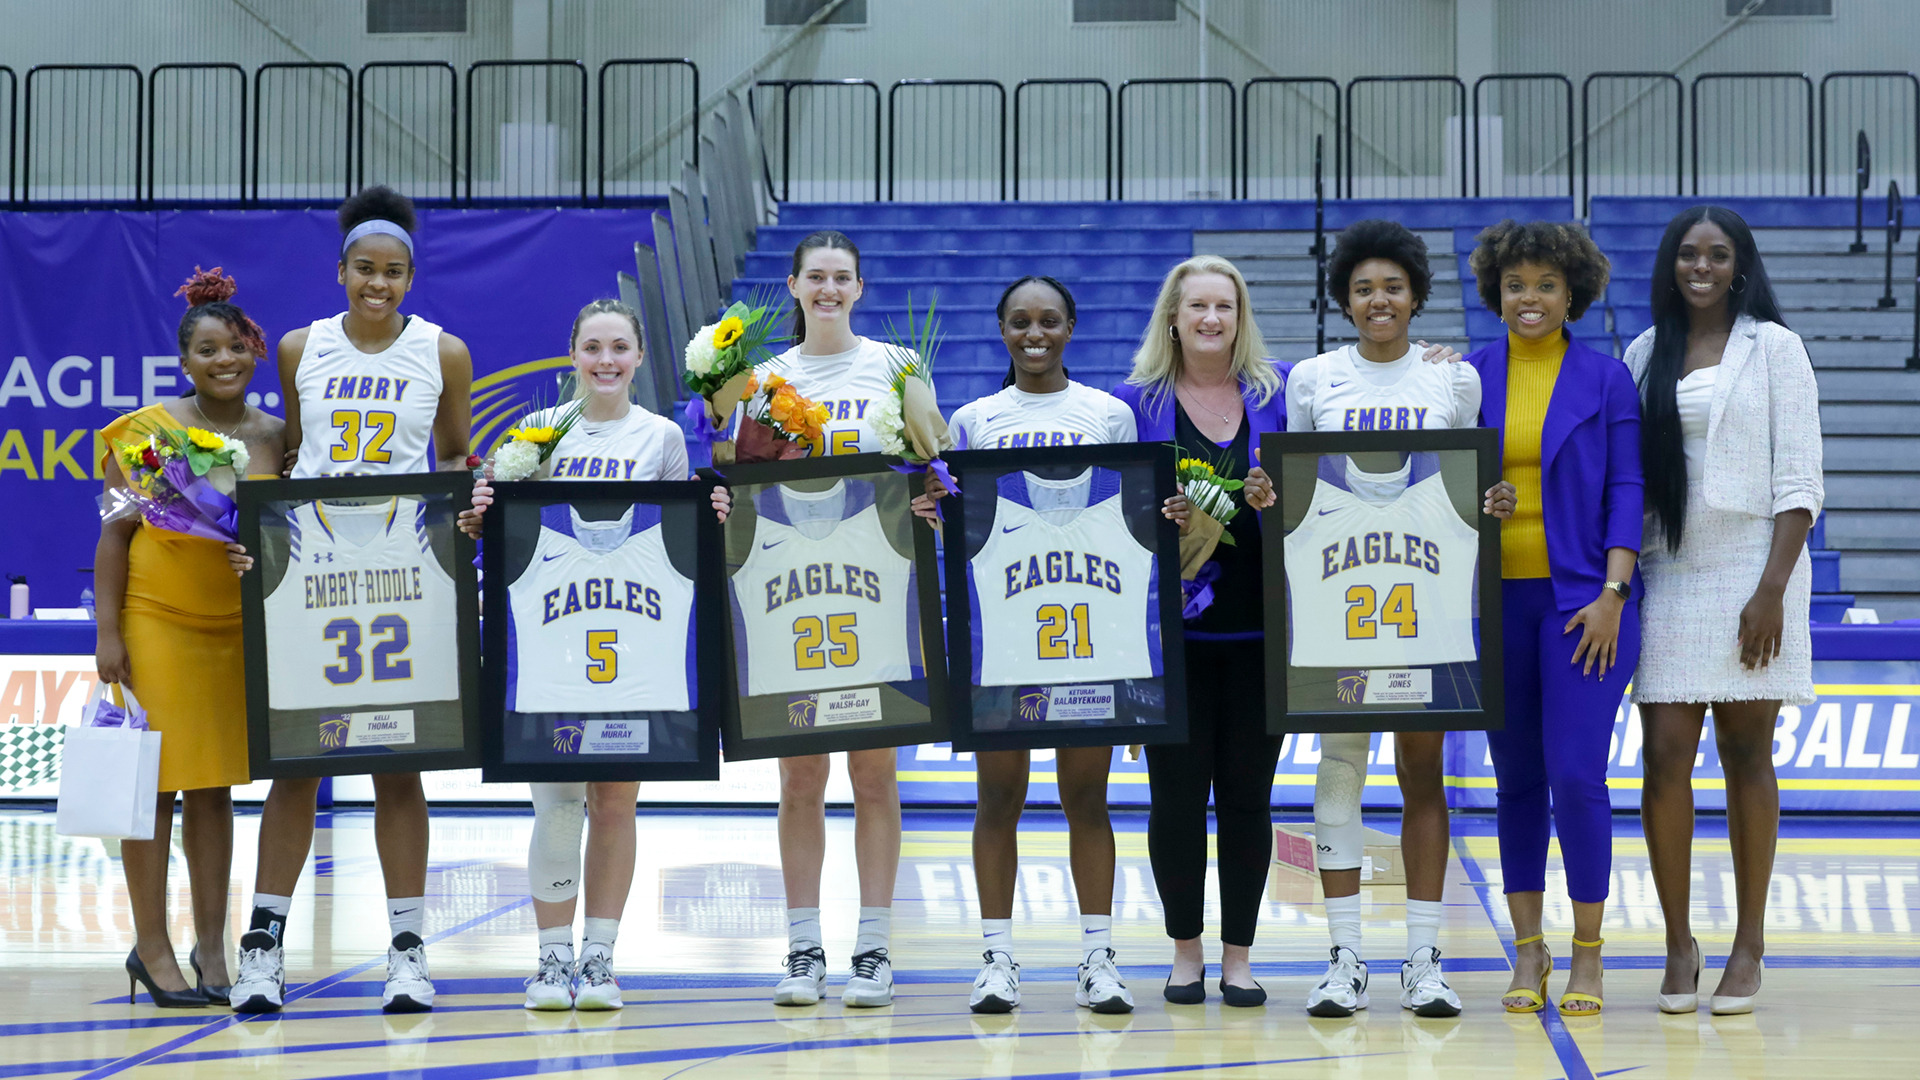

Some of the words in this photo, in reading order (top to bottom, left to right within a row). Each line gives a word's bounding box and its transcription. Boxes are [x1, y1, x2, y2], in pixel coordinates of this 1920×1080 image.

[323, 375, 410, 402] EMBRY
[330, 409, 396, 464] 32
[1343, 406, 1428, 431] EMBRY
[0, 429, 104, 481] AK
[552, 456, 638, 481] EMBRY
[1005, 550, 1121, 600] EAGLES
[1321, 531, 1440, 581] EAGLES
[304, 566, 422, 609] EMBRY-RIDDLE
[542, 578, 662, 626] EAGLES
[765, 562, 881, 615] EAGLES
[1345, 583, 1418, 640] 24
[322, 612, 414, 687] 32
[792, 612, 860, 671] 25
[1036, 603, 1094, 660] 21
[586, 629, 618, 684] 5
[828, 699, 871, 710] WALSH-GAY
[1054, 696, 1112, 706] BALABYEKKUBO
[1388, 680, 1412, 689] JONES
[367, 721, 398, 731] THOMAS
[601, 731, 633, 739] MURRAY
